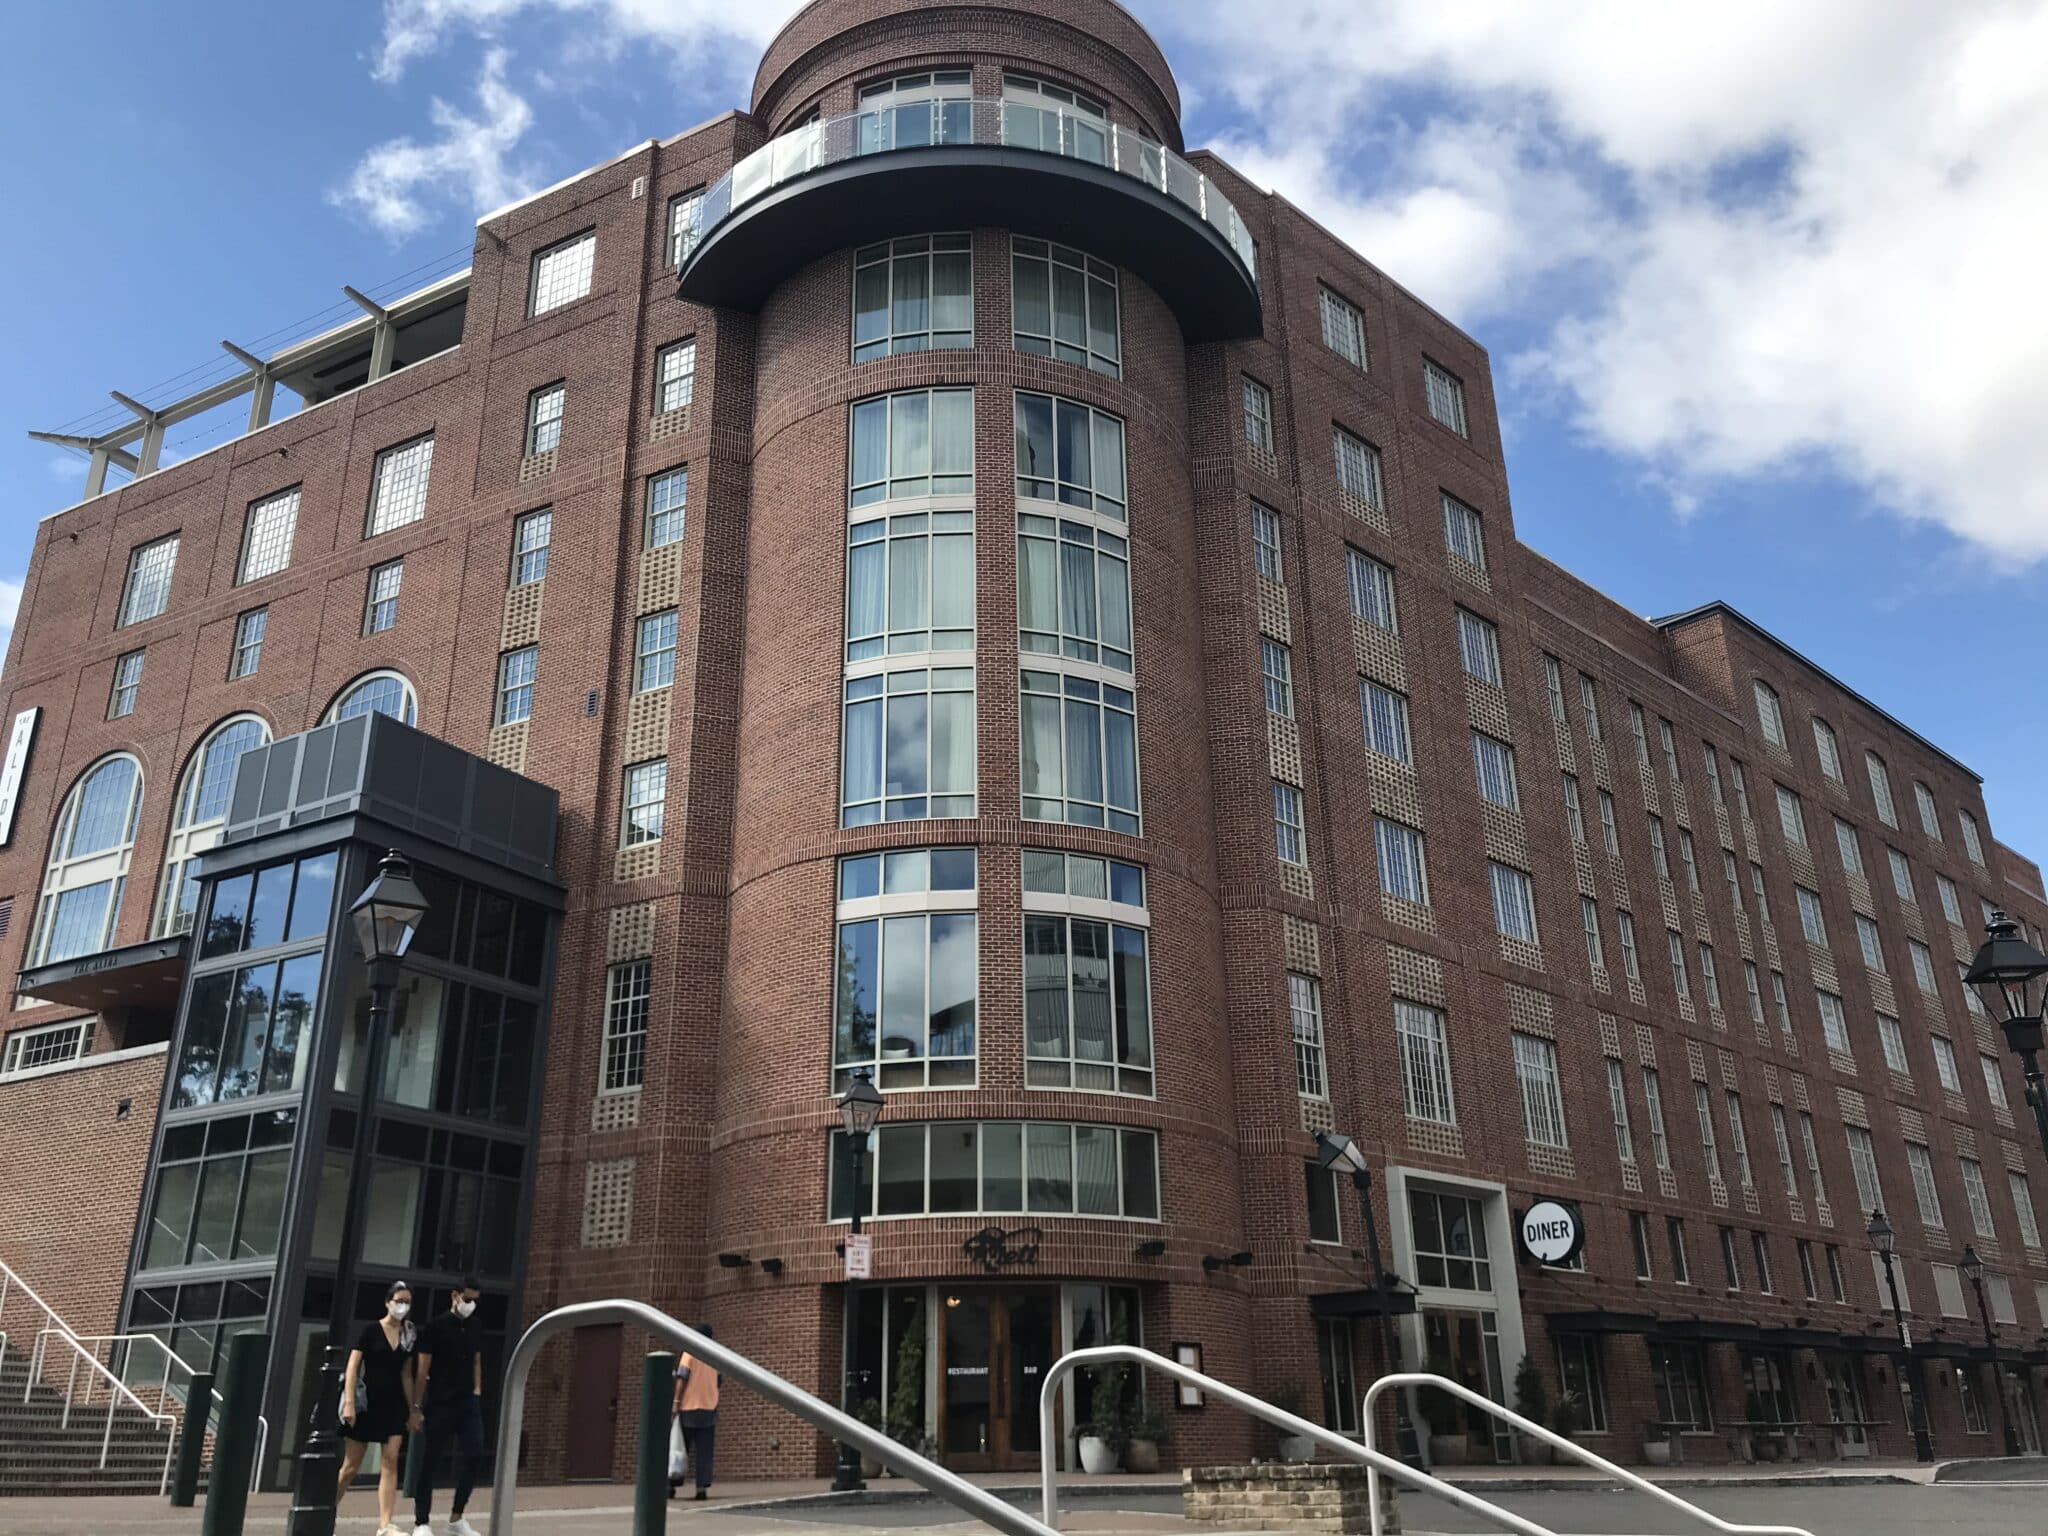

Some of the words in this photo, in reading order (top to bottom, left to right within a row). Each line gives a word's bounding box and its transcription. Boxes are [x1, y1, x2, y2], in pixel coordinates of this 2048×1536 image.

[0, 729, 24, 831] ALID
[1526, 1220, 1570, 1242] DINER
[947, 1367, 988, 1375] RESTAURANT
[1024, 1366, 1037, 1374] BAR
